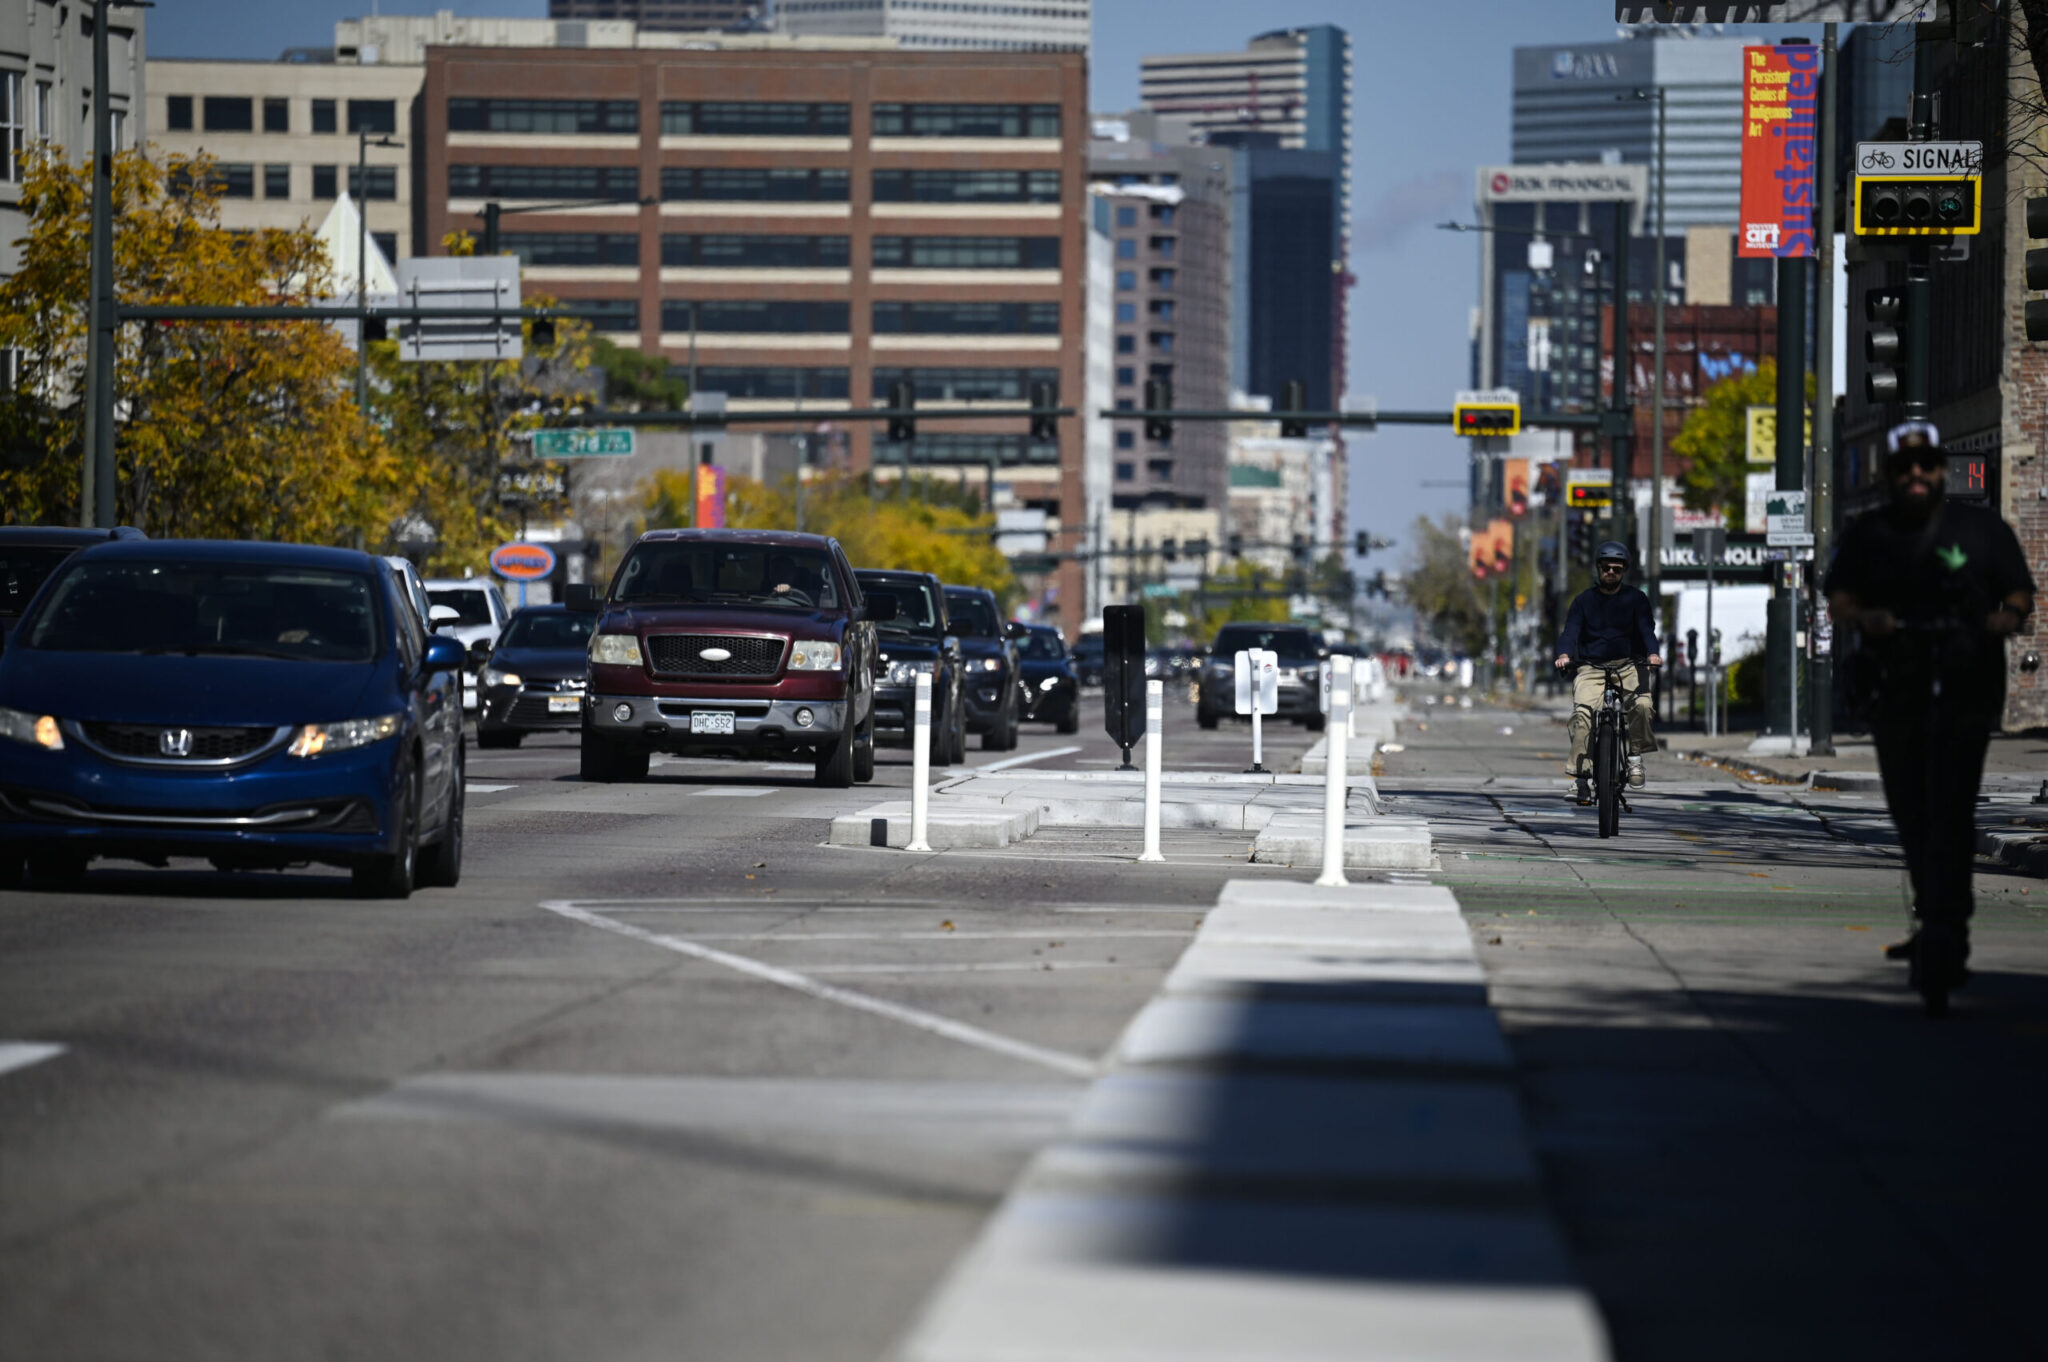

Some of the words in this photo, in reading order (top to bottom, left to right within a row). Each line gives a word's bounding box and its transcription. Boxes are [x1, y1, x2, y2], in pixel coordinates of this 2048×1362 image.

[1750, 51, 1766, 67] The
[1750, 69, 1791, 84] Persistent
[1750, 86, 1777, 102] Genius
[1749, 104, 1793, 123] Indigenous
[1748, 121, 1762, 137] Art
[1770, 46, 1818, 257] Sustained
[1903, 149, 1977, 169] SIGNAL
[1746, 228, 1780, 243] art
[1968, 462, 1985, 489] 14
